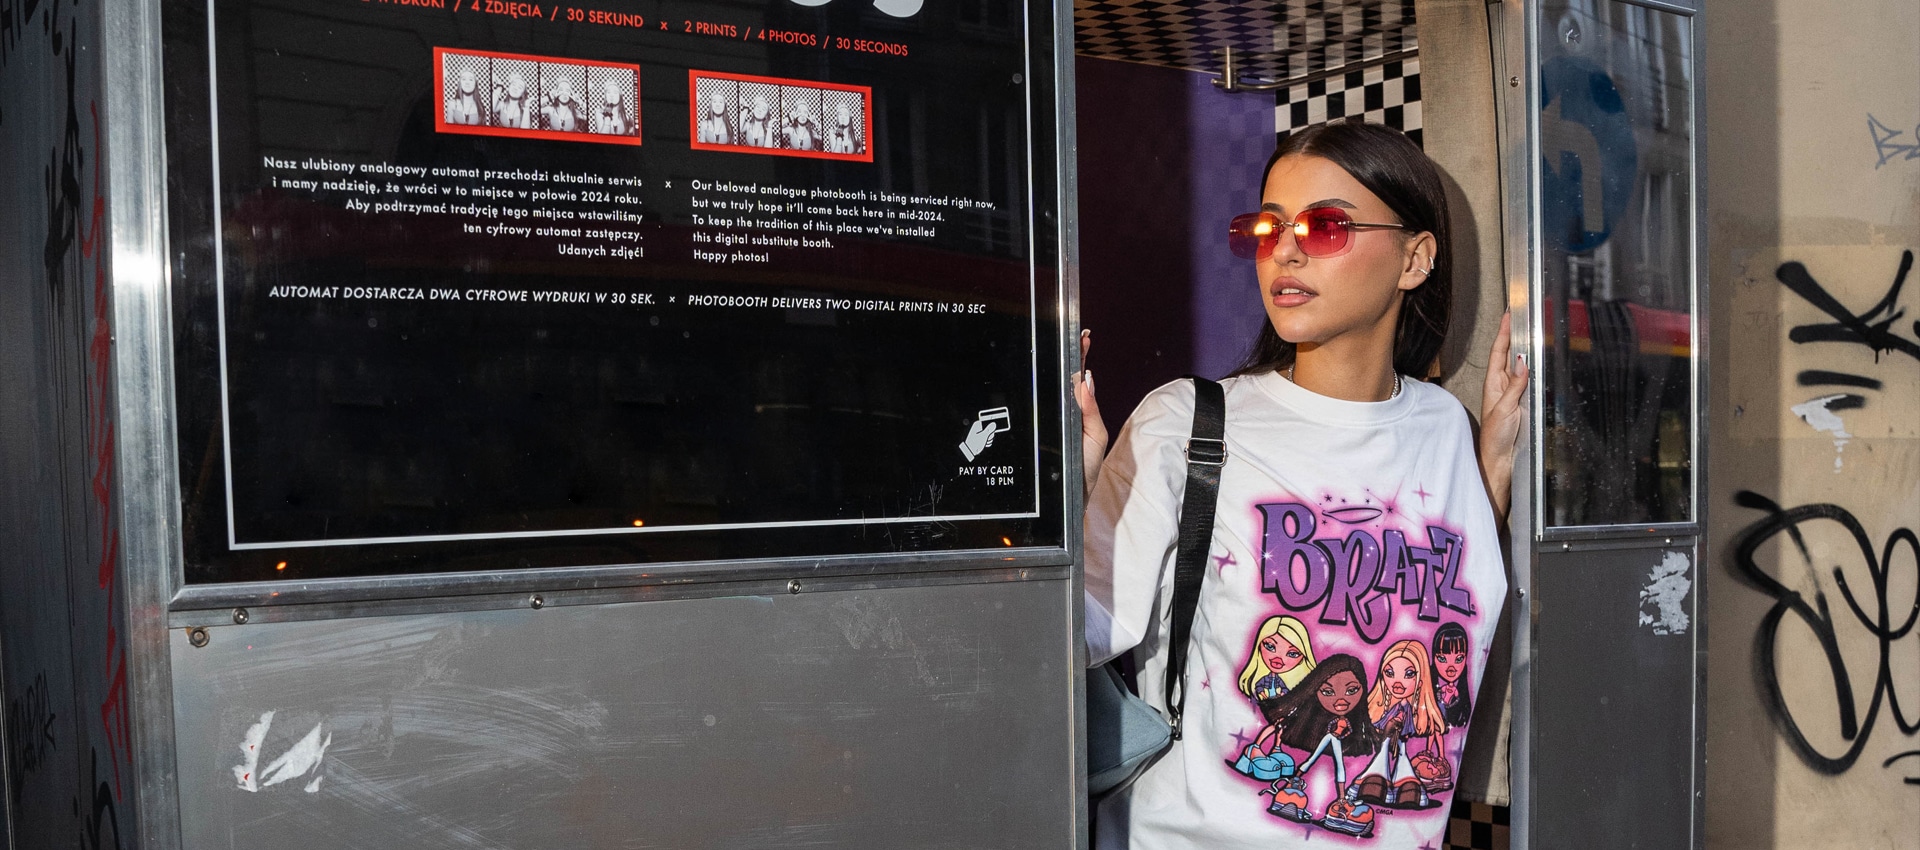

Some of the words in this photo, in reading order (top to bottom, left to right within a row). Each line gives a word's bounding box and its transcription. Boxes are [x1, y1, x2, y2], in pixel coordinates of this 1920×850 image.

[471, 0, 480, 12] 4
[485, 0, 542, 19] ZDJĘCIA
[567, 8, 584, 22] 30
[588, 10, 643, 27] SEKUND
[685, 20, 692, 32] 2
[696, 22, 737, 37] PRINTS
[758, 29, 765, 40] 4
[769, 29, 816, 46] PHOTOS
[837, 37, 850, 50] 30
[854, 39, 908, 56] SECONDS
[264, 156, 297, 169] Nasz
[302, 158, 355, 175] ulubiony
[360, 161, 427, 178] analogowy
[432, 167, 479, 178] automat
[484, 168, 548, 181] przechodzi
[553, 171, 604, 184] aktualnie
[608, 176, 642, 187] serwis
[273, 176, 276, 187] i
[282, 180, 318, 192] mamy
[323, 178, 380, 194] nadzieję,
[386, 182, 400, 193] że
[404, 183, 437, 194] wróci
[456, 186, 467, 196] to
[472, 186, 514, 200] miejsce
[532, 188, 577, 202] połowie
[581, 191, 610, 202] 2024
[615, 192, 642, 204] roku.
[692, 179, 712, 190] Our
[716, 180, 756, 193] beloved
[760, 184, 806, 198] analogue
[811, 187, 866, 200] photobooth
[870, 191, 877, 201] is
[881, 191, 906, 205] being
[910, 195, 948, 206] serviced
[951, 197, 972, 209] right
[975, 201, 996, 210] now,
[346, 198, 370, 213] Aby
[375, 200, 446, 215] podtrzymać
[451, 203, 498, 218] tradycję
[503, 206, 528, 219] tego
[533, 207, 574, 221] miejsca
[578, 210, 643, 225] wstawiliśmy
[692, 196, 708, 208] but
[712, 201, 726, 209] we
[730, 199, 754, 213] truly
[758, 200, 782, 214] hope
[807, 207, 832, 215] come
[836, 205, 859, 216] back
[862, 206, 883, 218] here
[887, 209, 895, 218] in
[899, 210, 945, 221] mid-2024.
[464, 223, 482, 233] ten
[486, 222, 531, 238] cyfrowy
[536, 227, 581, 237] automat
[586, 229, 643, 242] zastępczy.
[692, 214, 704, 225] To
[708, 214, 733, 229] keep
[737, 216, 752, 227] the
[756, 218, 799, 229] tradition
[803, 220, 813, 230] of
[816, 220, 833, 232] this
[837, 222, 862, 234] place
[896, 226, 935, 237] installed
[558, 243, 606, 258] Udanych
[611, 245, 643, 260] zdjęć!
[693, 231, 711, 242] this
[715, 232, 748, 246] digital
[752, 234, 798, 247] substitute
[802, 236, 834, 248] booth.
[694, 249, 727, 263] Happy
[732, 250, 769, 263] photos!
[269, 286, 339, 298] AUTOMAT
[343, 287, 424, 299] DOSTARCZA
[430, 288, 460, 300] DWA
[466, 289, 528, 301] CYFROWE
[532, 291, 590, 303] WYDRUKI
[595, 292, 607, 303] W
[611, 293, 626, 304] 30
[630, 293, 655, 304] SEK.
[688, 295, 768, 307] PHOTOBOOTH
[772, 297, 821, 309] DELIVERS
[826, 299, 851, 310] TWO
[855, 300, 895, 311] DIGITAL
[899, 301, 933, 312] PRINTS
[937, 303, 948, 312] IN
[952, 303, 964, 313] 30
[968, 304, 986, 314] SEC
[959, 467, 974, 475] PAY
[978, 466, 987, 475] BY
[990, 466, 1013, 475] CARD
[986, 477, 995, 486] 18
[999, 477, 1014, 485] PLN
[1256, 503, 1476, 644] BRATZ
